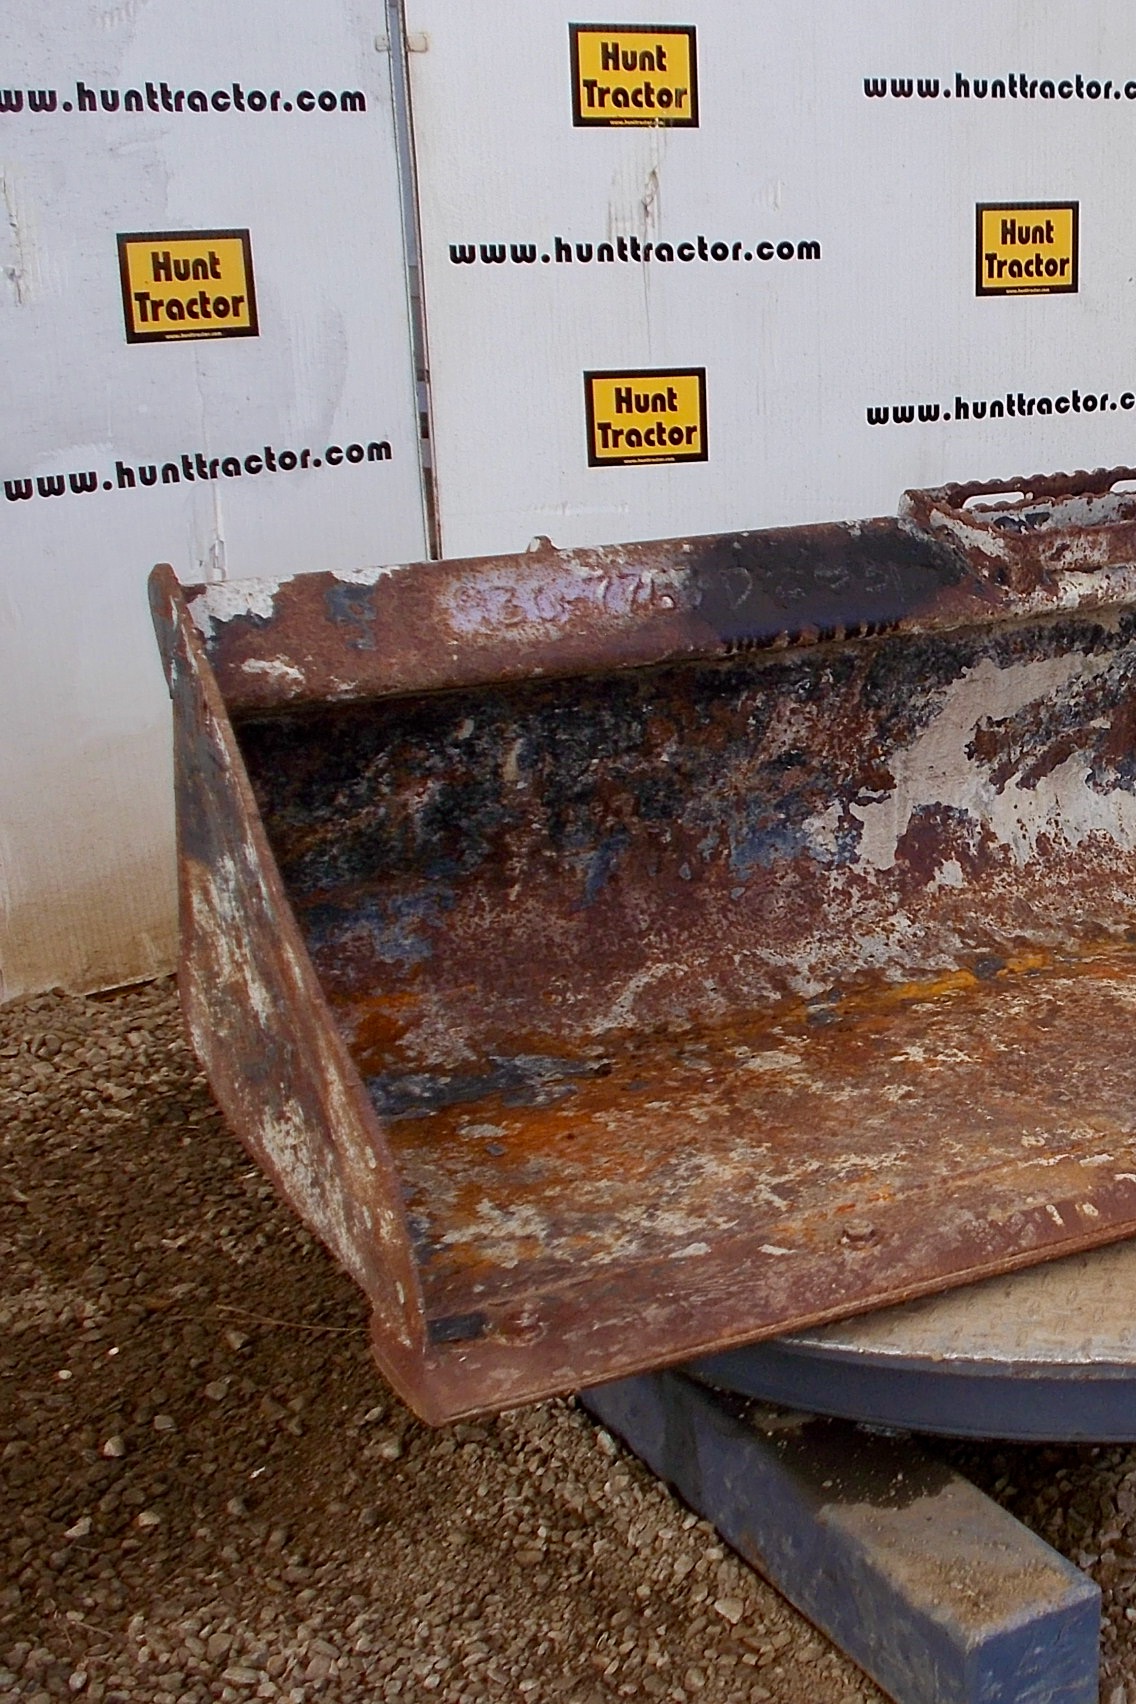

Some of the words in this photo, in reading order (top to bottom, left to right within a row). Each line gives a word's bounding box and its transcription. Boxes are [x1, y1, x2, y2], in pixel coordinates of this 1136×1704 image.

[601, 43, 666, 71] Hunt
[0, 82, 366, 112] ww.hunttractor.com
[583, 79, 687, 108] Tractor
[1002, 219, 1053, 244] Hunt
[450, 236, 820, 264] www.hunttractor.com
[151, 252, 221, 281] Hunt
[985, 253, 1069, 278] Tractor
[134, 291, 244, 322] Tractor
[615, 388, 677, 413] Hunt
[598, 422, 697, 448] Tractor
[4, 442, 391, 501] www.hunttractor.com
